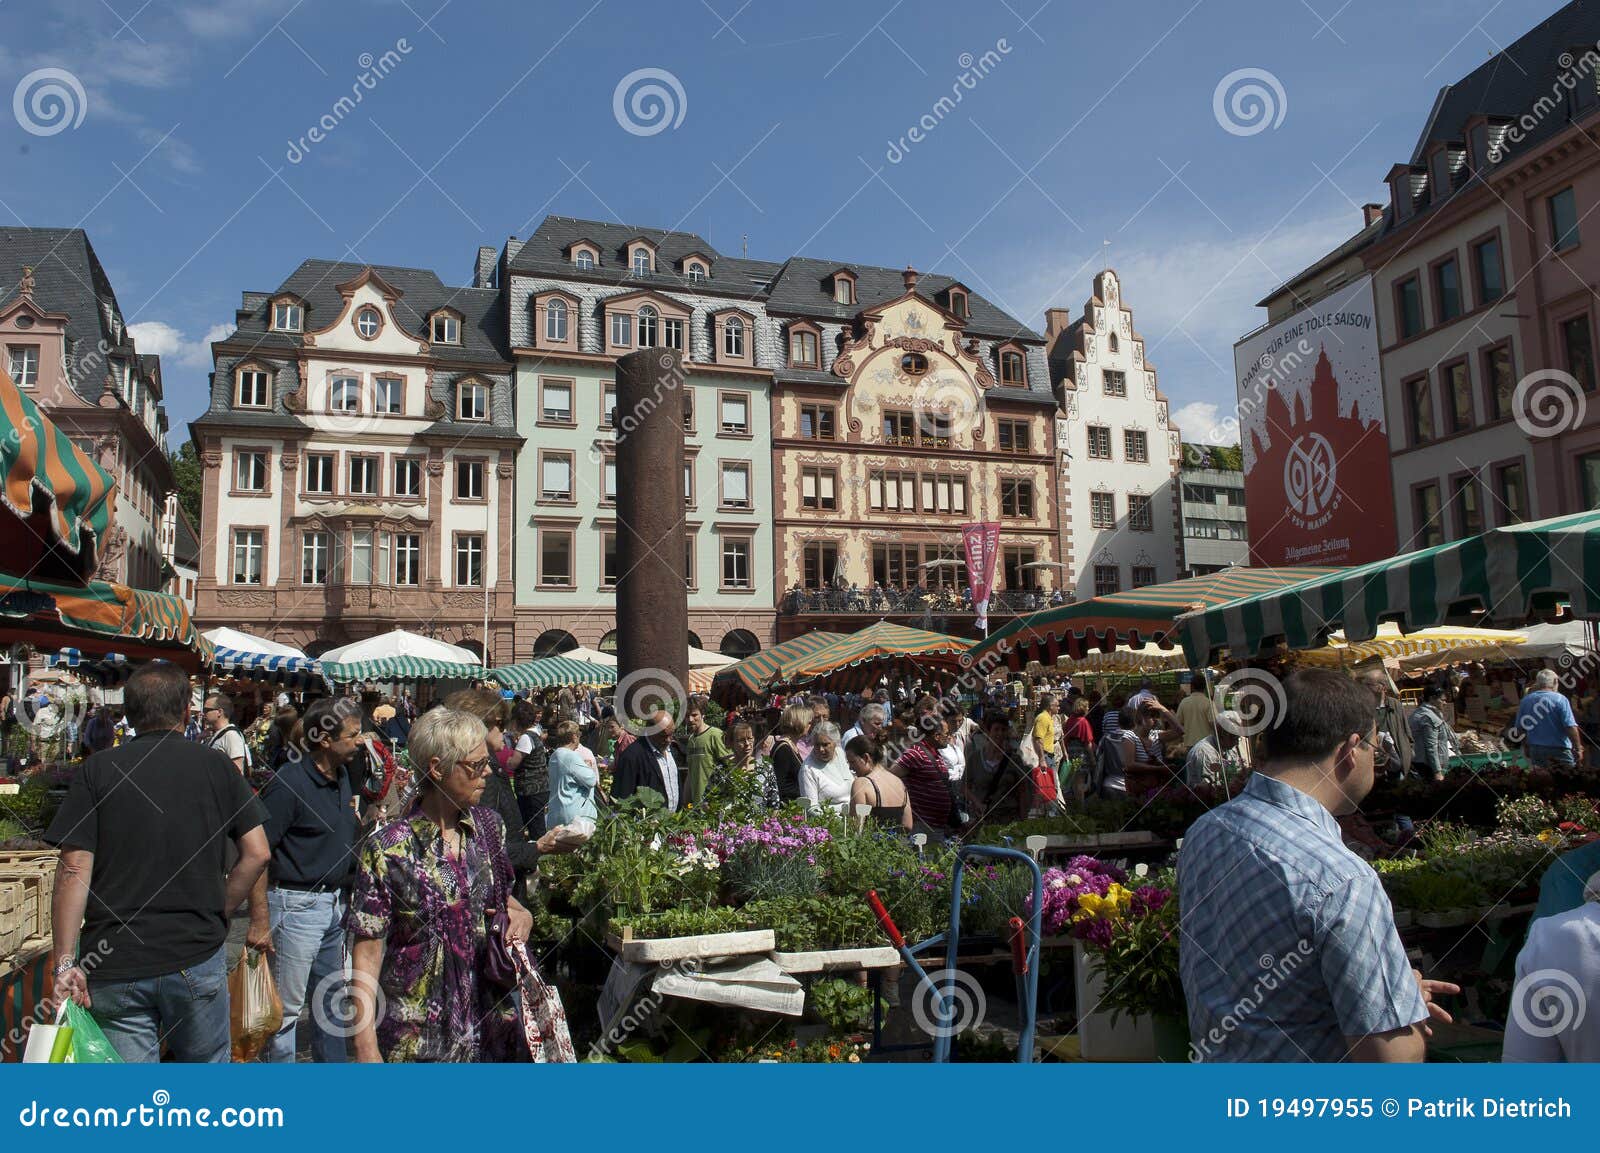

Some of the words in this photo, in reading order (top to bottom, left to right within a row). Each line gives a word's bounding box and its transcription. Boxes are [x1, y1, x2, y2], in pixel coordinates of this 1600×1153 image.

[1284, 323, 1304, 344] EINE
[1305, 313, 1332, 333] TOLLE
[1334, 312, 1371, 329] SAISON
[1307, 510, 1333, 531] MAINZ
[986, 530, 996, 553] 2011
[1285, 545, 1321, 560] Allgemeine
[1322, 537, 1351, 552] Zeitung
[970, 535, 984, 585] Mainz
